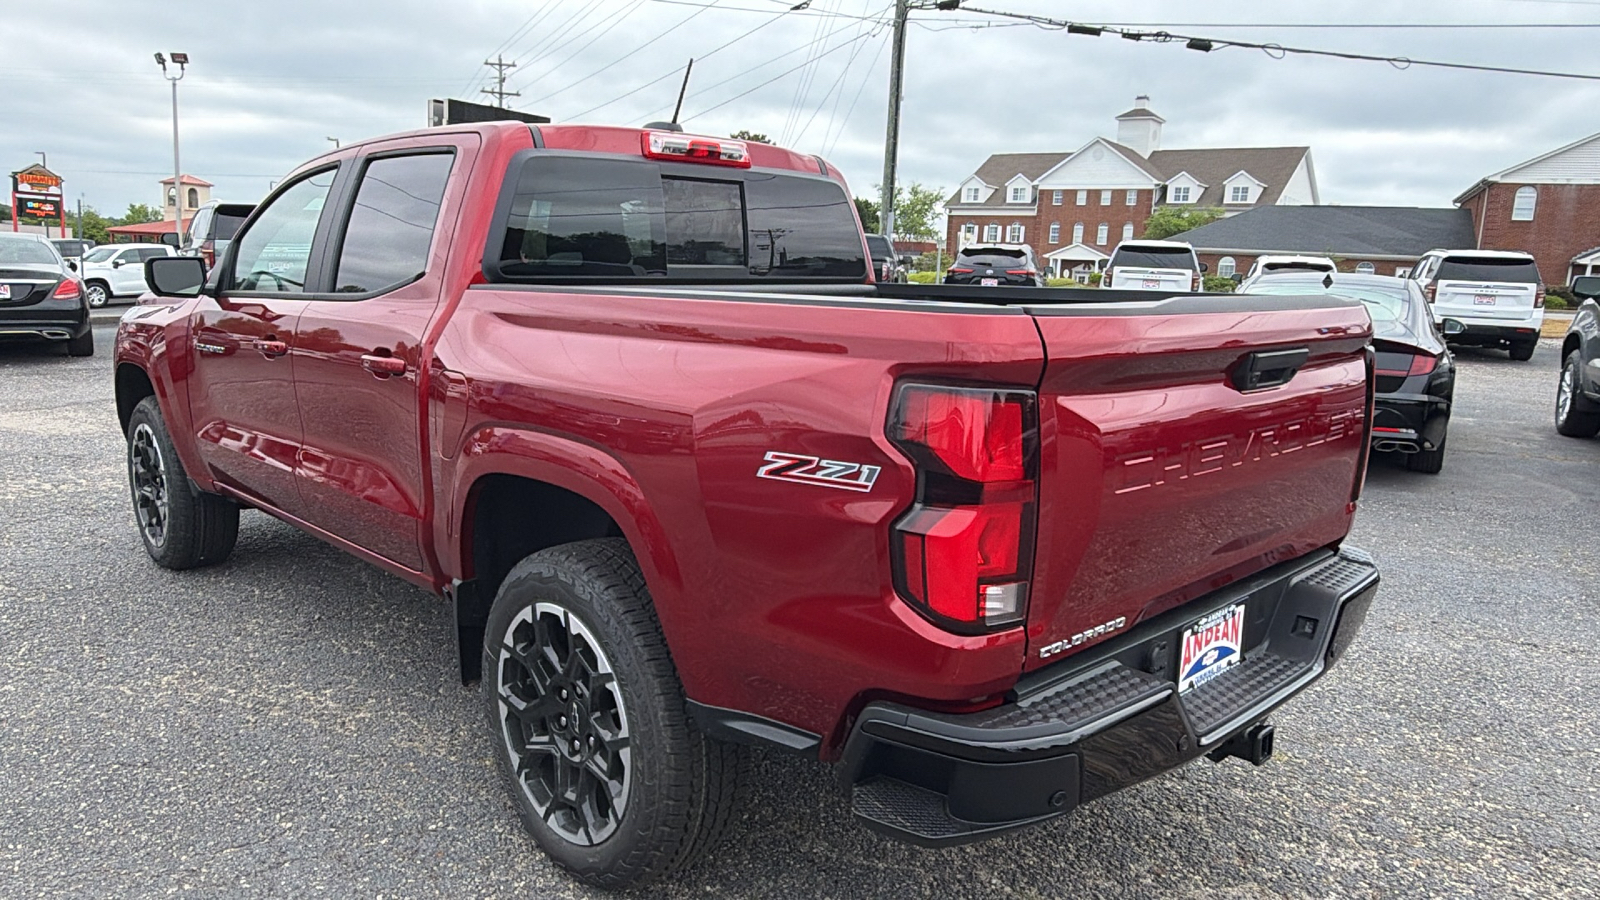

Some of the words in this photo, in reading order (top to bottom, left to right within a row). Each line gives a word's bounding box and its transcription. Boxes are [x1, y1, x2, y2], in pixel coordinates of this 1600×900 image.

[18, 173, 59, 187] SUMMITS
[756, 451, 882, 493] Z71
[1039, 616, 1126, 659] COLORADO
[1181, 611, 1241, 674] ANDEAN
